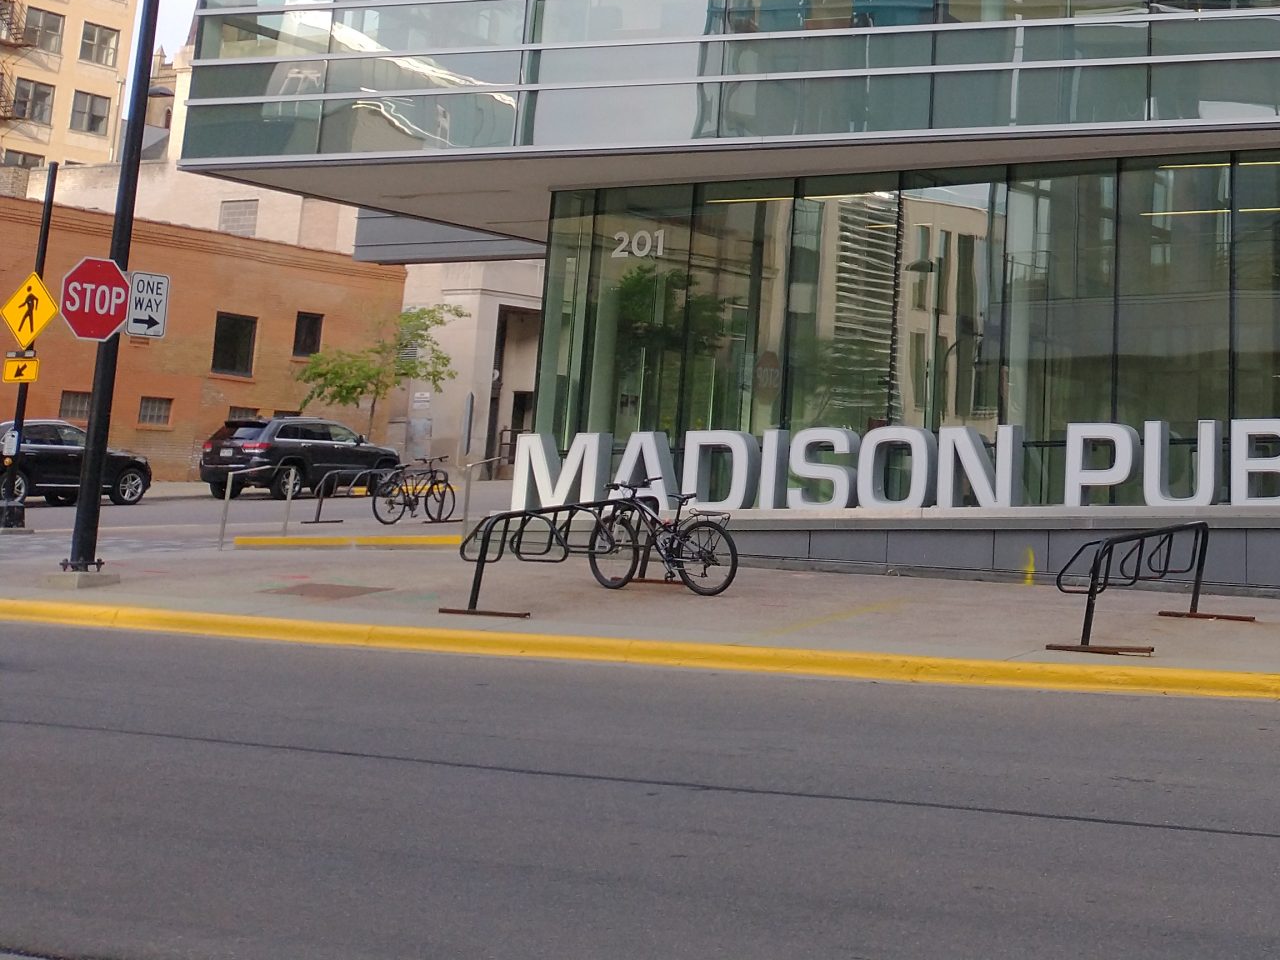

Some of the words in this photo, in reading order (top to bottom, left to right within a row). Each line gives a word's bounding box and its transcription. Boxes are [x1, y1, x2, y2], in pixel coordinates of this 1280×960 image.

[611, 229, 665, 258] 201
[65, 281, 126, 316] STOP
[136, 279, 164, 296] ONE
[134, 296, 162, 313] WAY
[510, 424, 1023, 511] MADISON
